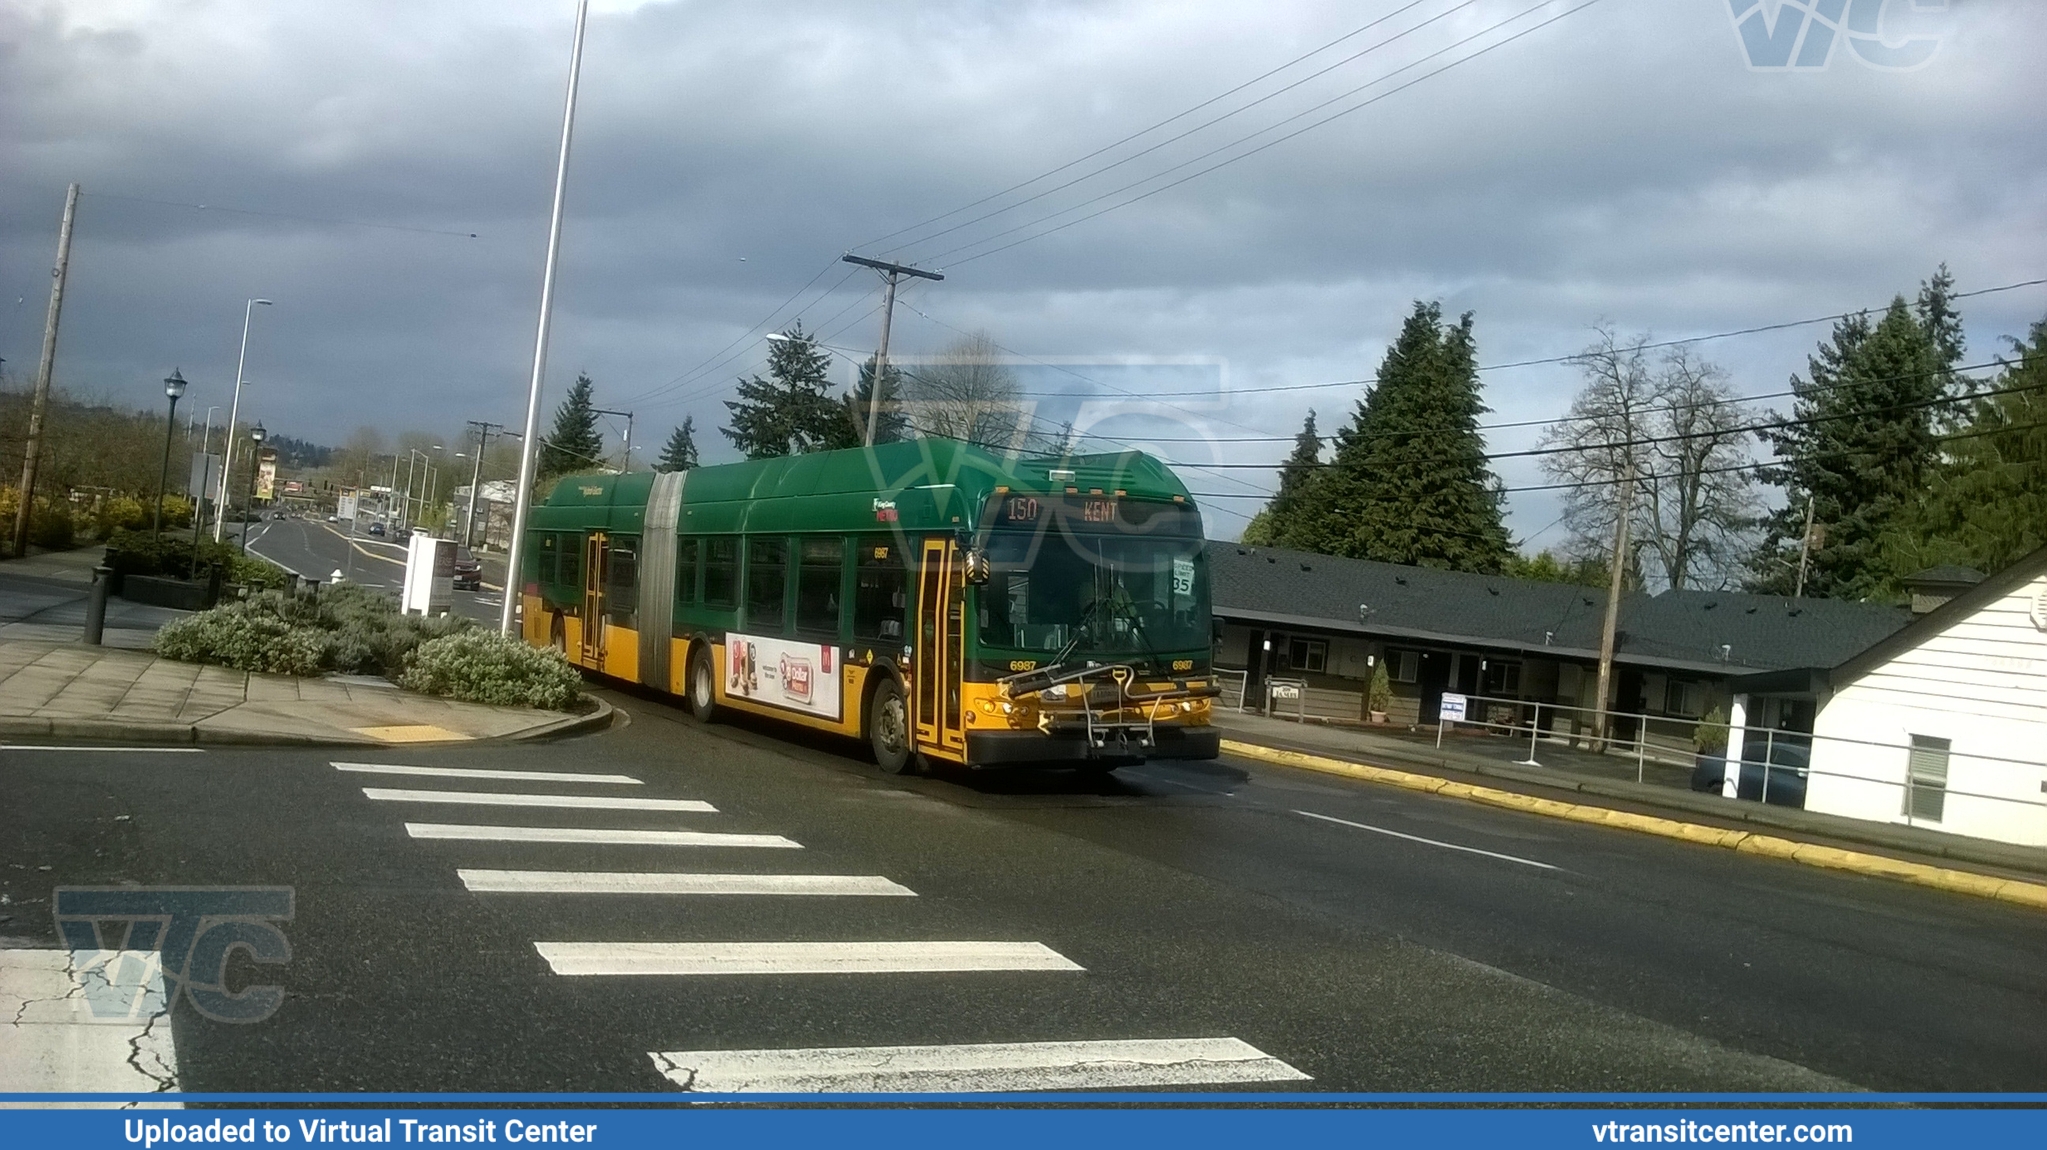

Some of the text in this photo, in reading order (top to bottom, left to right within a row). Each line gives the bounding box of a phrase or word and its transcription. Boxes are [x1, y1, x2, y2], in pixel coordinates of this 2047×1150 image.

[1008, 498, 1038, 520] 150
[1084, 501, 1117, 521] KENT
[1173, 577, 1190, 592] 35
[1010, 660, 1037, 671] 6987
[1172, 660, 1194, 671] 6987
[792, 667, 808, 682] Dollar
